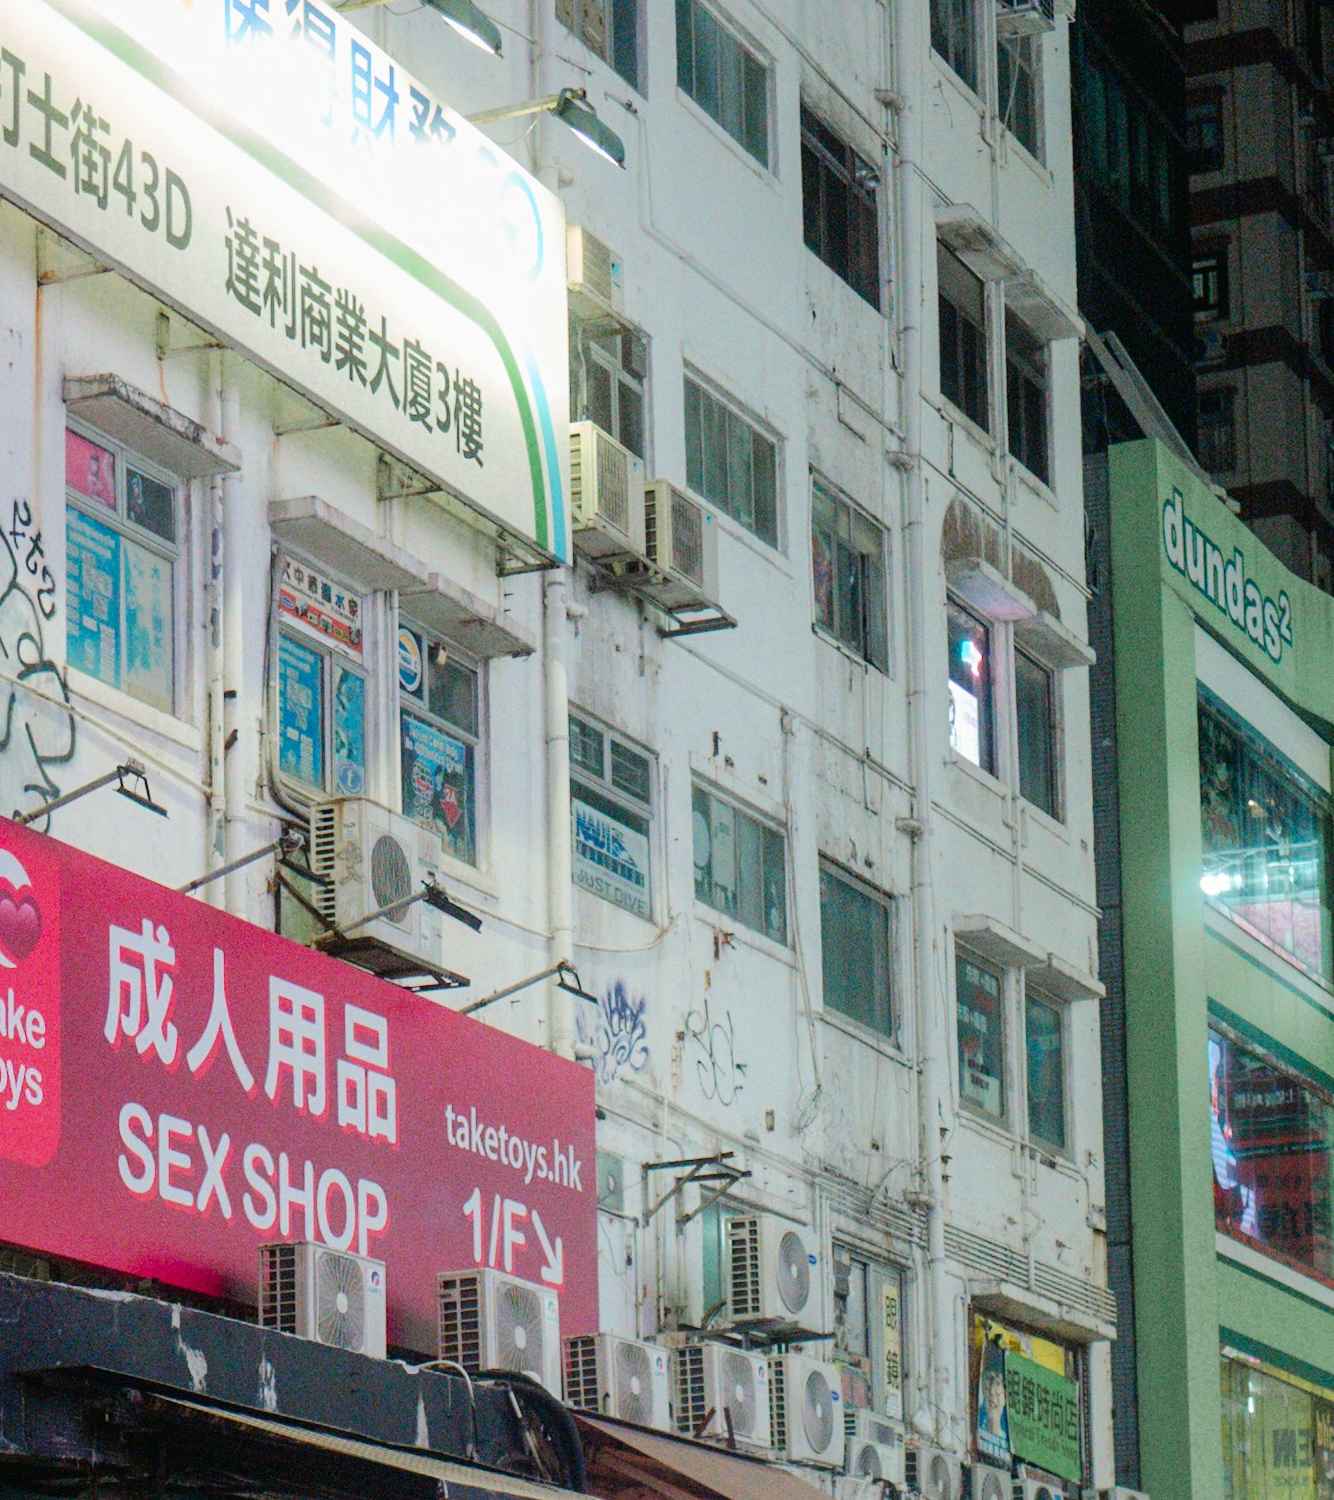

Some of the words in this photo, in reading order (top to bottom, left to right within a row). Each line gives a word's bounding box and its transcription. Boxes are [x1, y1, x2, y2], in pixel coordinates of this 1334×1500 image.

[225, 206, 485, 470] 達利商業大廈3樓
[613, 885, 646, 915] DIVE
[103, 917, 397, 1143] 成人用品
[118, 1102, 231, 1222] SEX
[244, 1144, 387, 1256] SHOP
[445, 1103, 583, 1193] taketoys.hk
[463, 1187, 527, 1275] 1/F
[884, 1294, 900, 1391] 眼鏡
[1007, 1367, 1078, 1443] 眼鏡時尚店
